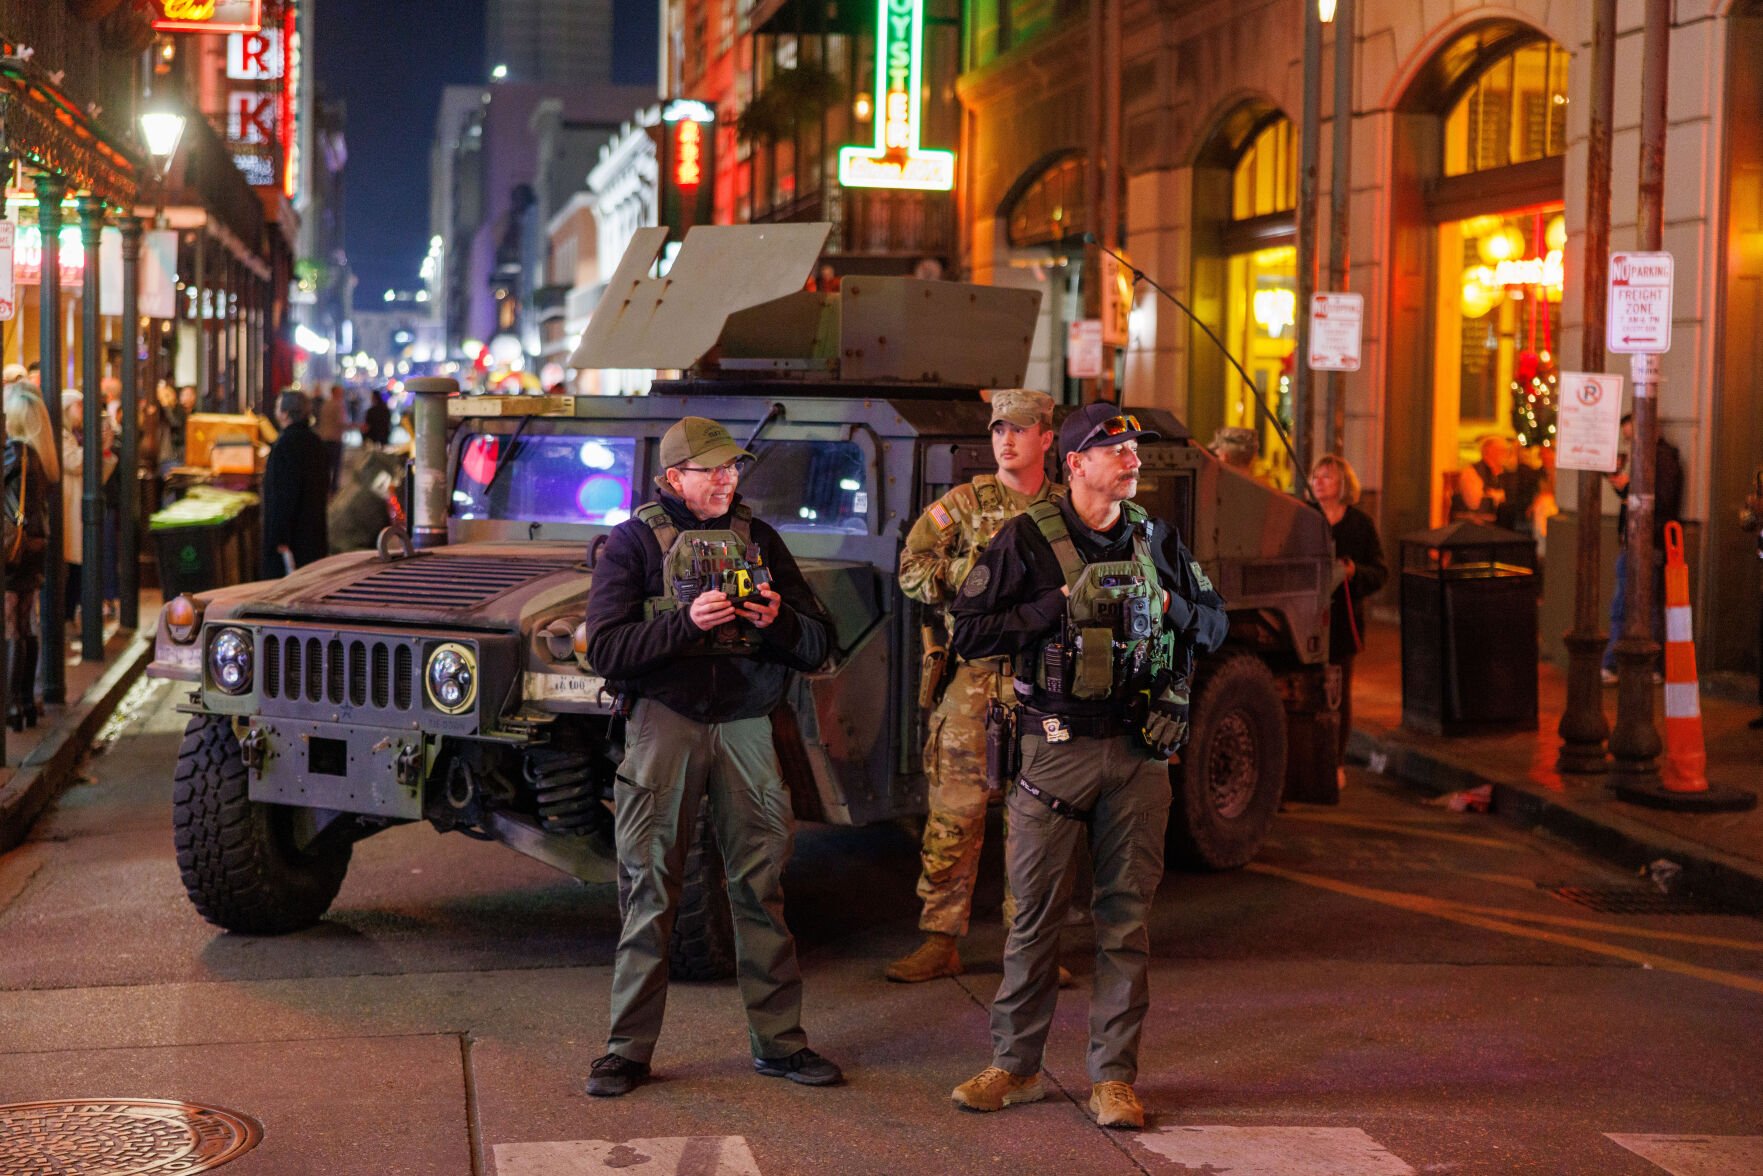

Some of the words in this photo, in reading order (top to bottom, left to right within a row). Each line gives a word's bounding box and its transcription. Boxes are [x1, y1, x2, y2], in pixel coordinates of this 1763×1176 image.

[1631, 264, 1670, 278] PARKING
[1618, 289, 1663, 302] FREIGHT
[1625, 303, 1653, 315] ZONE
